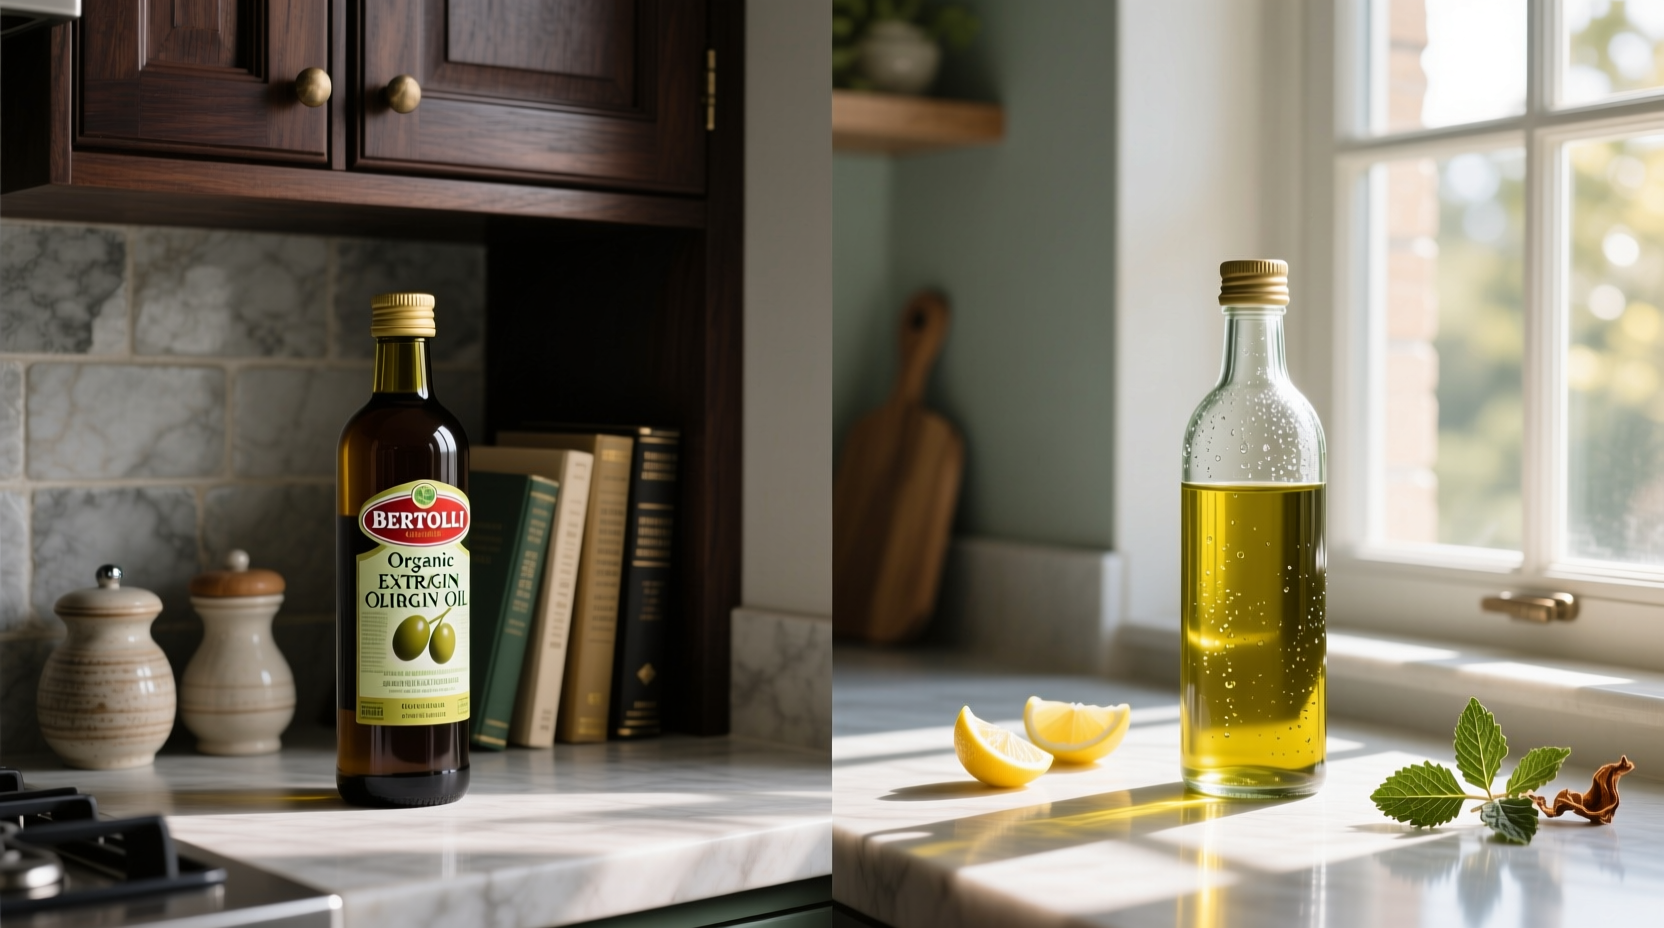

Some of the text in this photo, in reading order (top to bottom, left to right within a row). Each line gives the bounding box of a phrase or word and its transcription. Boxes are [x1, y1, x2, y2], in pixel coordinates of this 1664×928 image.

[371, 510, 465, 529] BERTOLLI
[387, 551, 454, 573] Organic
[444, 590, 468, 607] OIL
